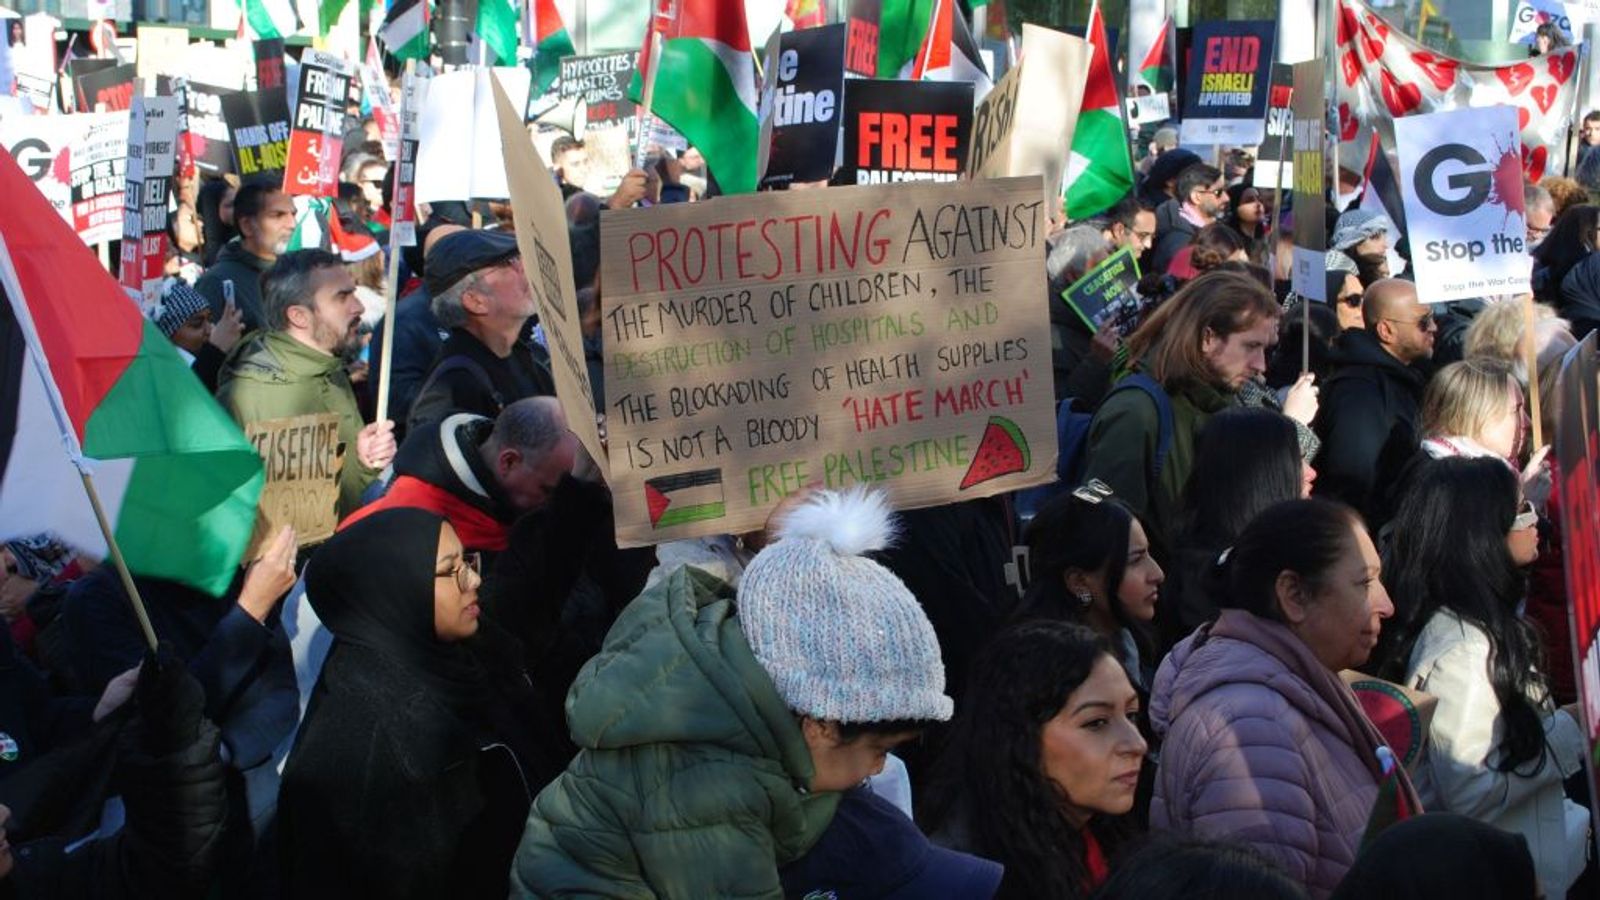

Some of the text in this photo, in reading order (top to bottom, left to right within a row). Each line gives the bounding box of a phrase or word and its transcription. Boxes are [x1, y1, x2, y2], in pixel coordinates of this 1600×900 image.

[847, 17, 878, 77] FREE
[1204, 36, 1260, 72] END
[1199, 93, 1251, 106] APARTHEID
[1202, 73, 1253, 92] ISRAELI
[268, 121, 289, 143] OFF
[858, 112, 958, 171] FREE
[629, 208, 891, 292] PROTESTING
[902, 200, 1044, 263] AGAINST
[1425, 232, 1523, 262] Stop the
[608, 303, 654, 342] THE
[658, 290, 757, 335] MURDER
[770, 285, 797, 319] OF
[948, 266, 993, 295] THE
[1487, 278, 1506, 287] War
[613, 302, 998, 379] DESTRUCTION OF HOSPITALS AND
[614, 338, 1028, 424] THE BLOCKADING OF HEALTH SUPPLIES
[626, 368, 1029, 469] IS NOT A BLOODY 'HATE MARCH'
[748, 434, 969, 505] FREE PALESTINE
